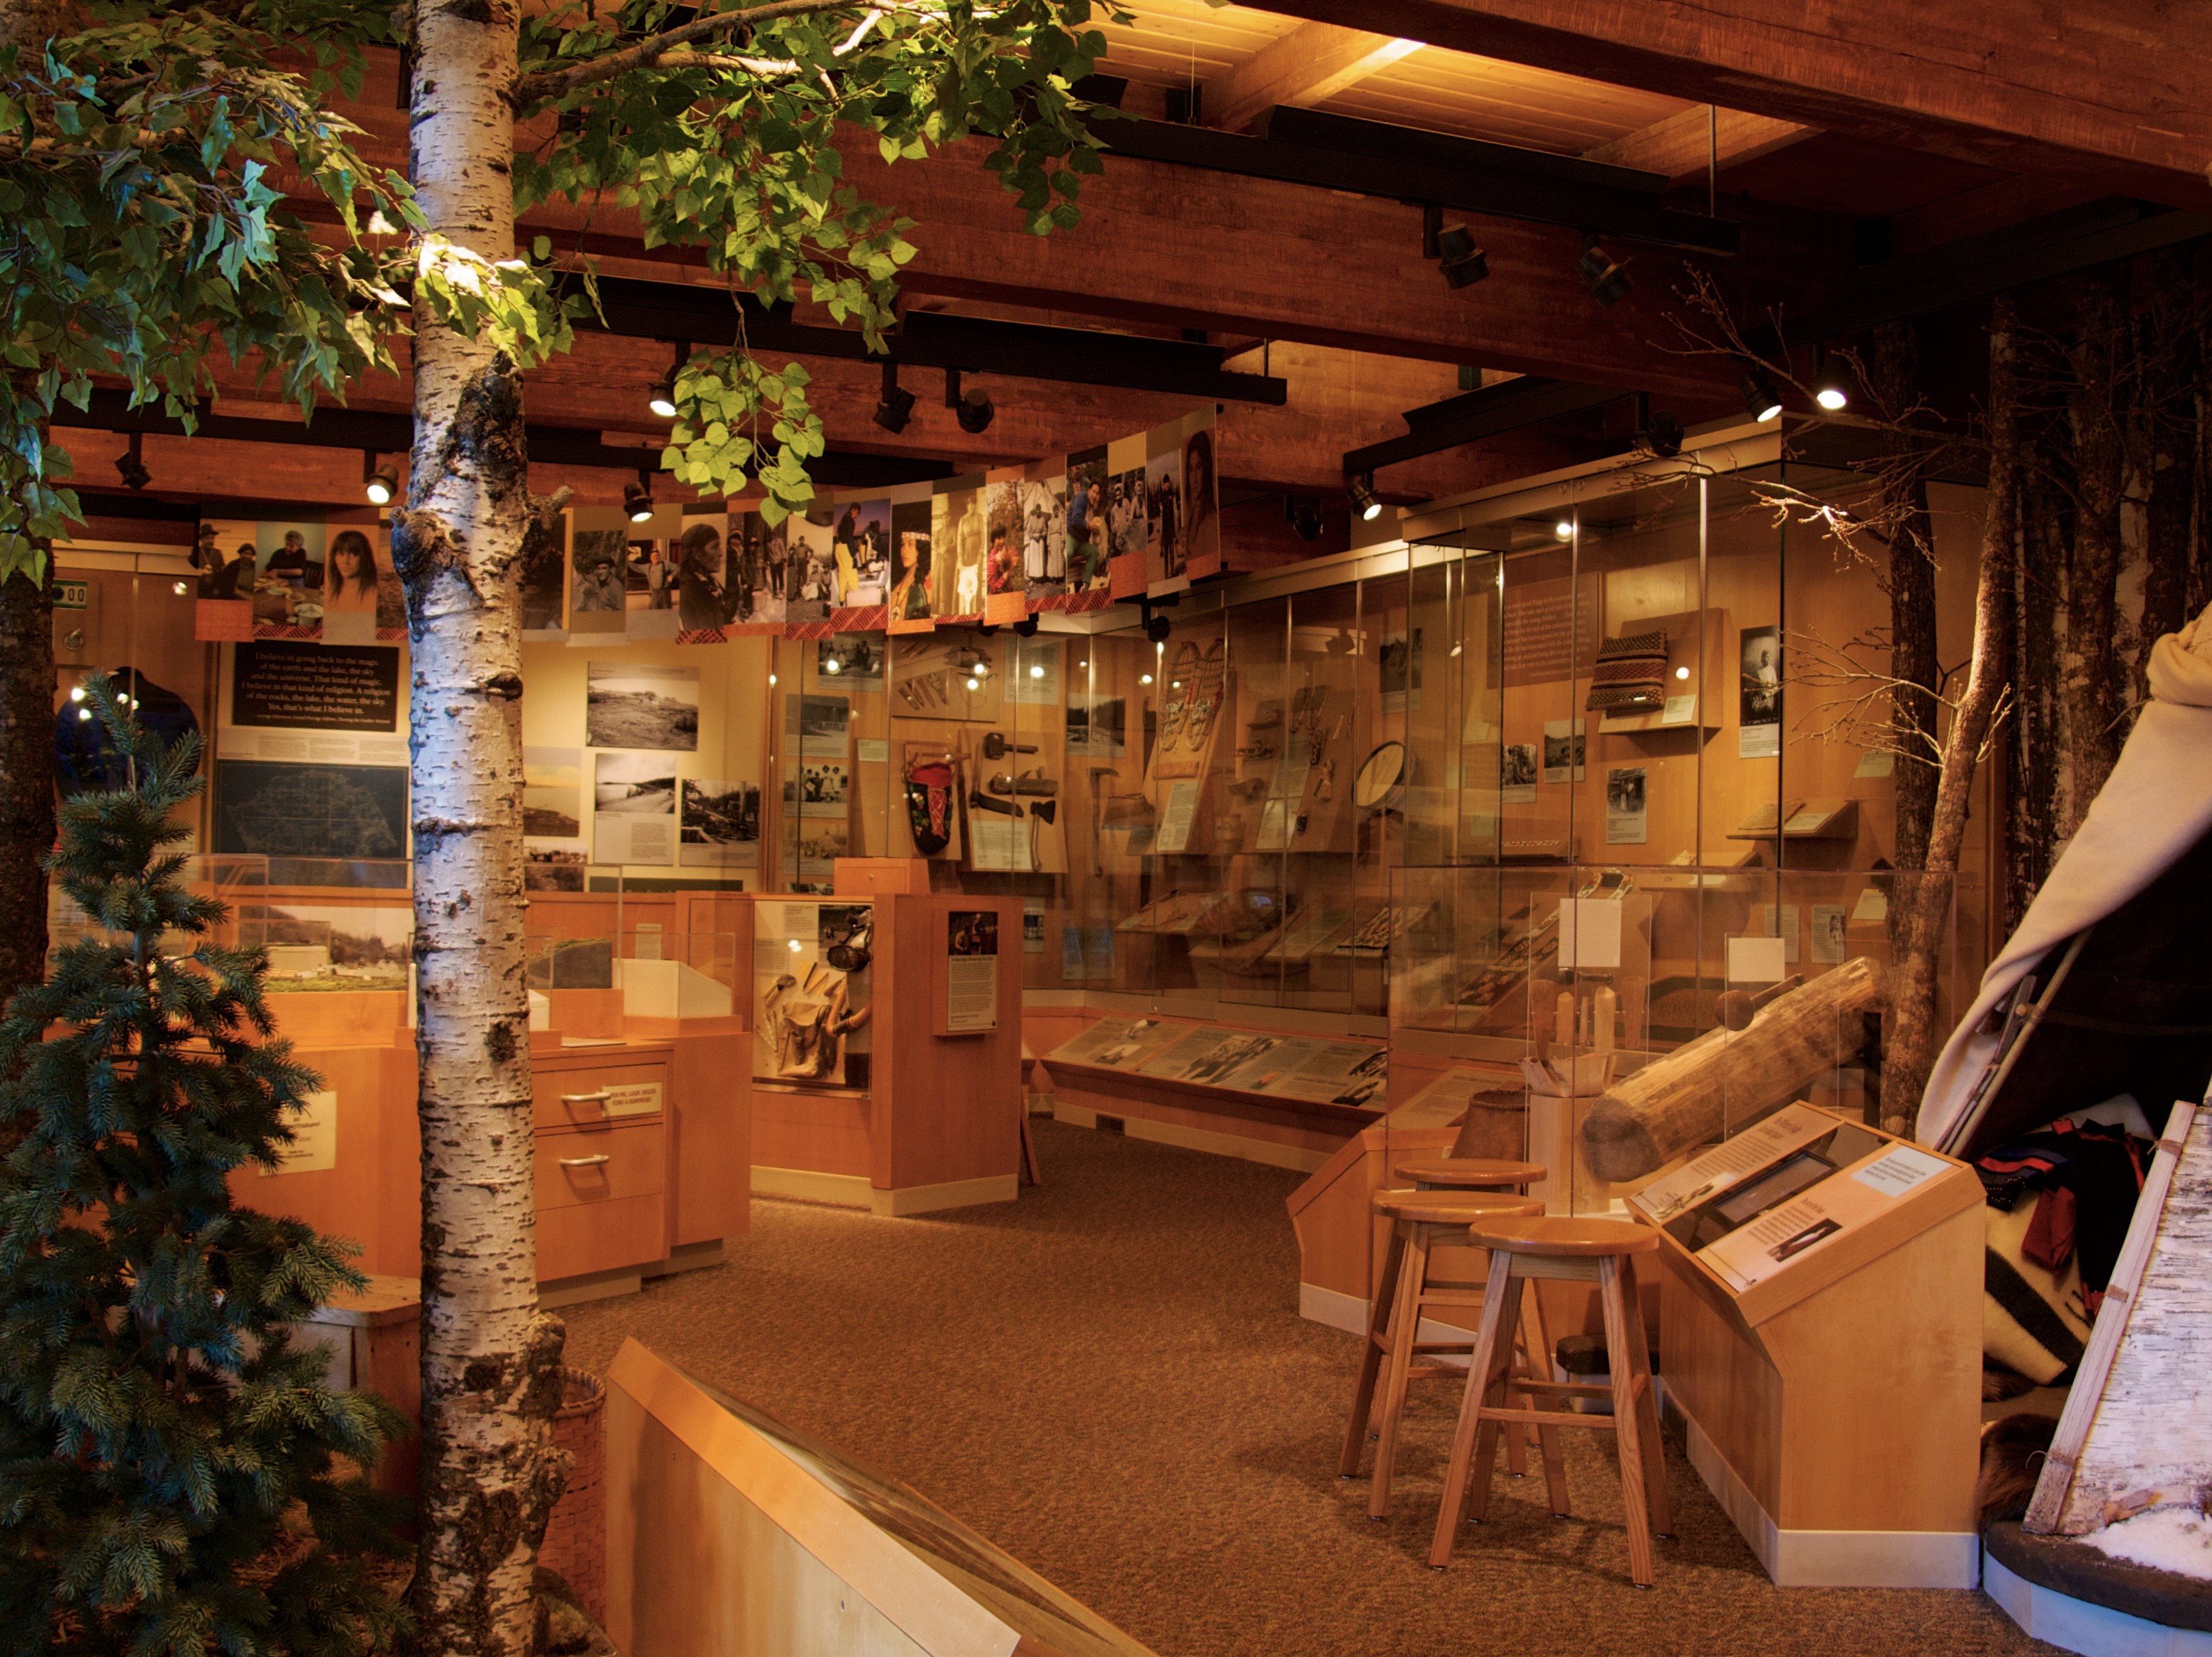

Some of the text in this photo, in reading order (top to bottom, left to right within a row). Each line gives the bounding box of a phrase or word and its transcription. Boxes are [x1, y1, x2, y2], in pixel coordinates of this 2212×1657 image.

[260, 652, 286, 660] believe
[314, 674, 330, 683] That
[246, 681, 272, 690] believe
[363, 688, 391, 697] religion
[328, 705, 354, 713] believe
